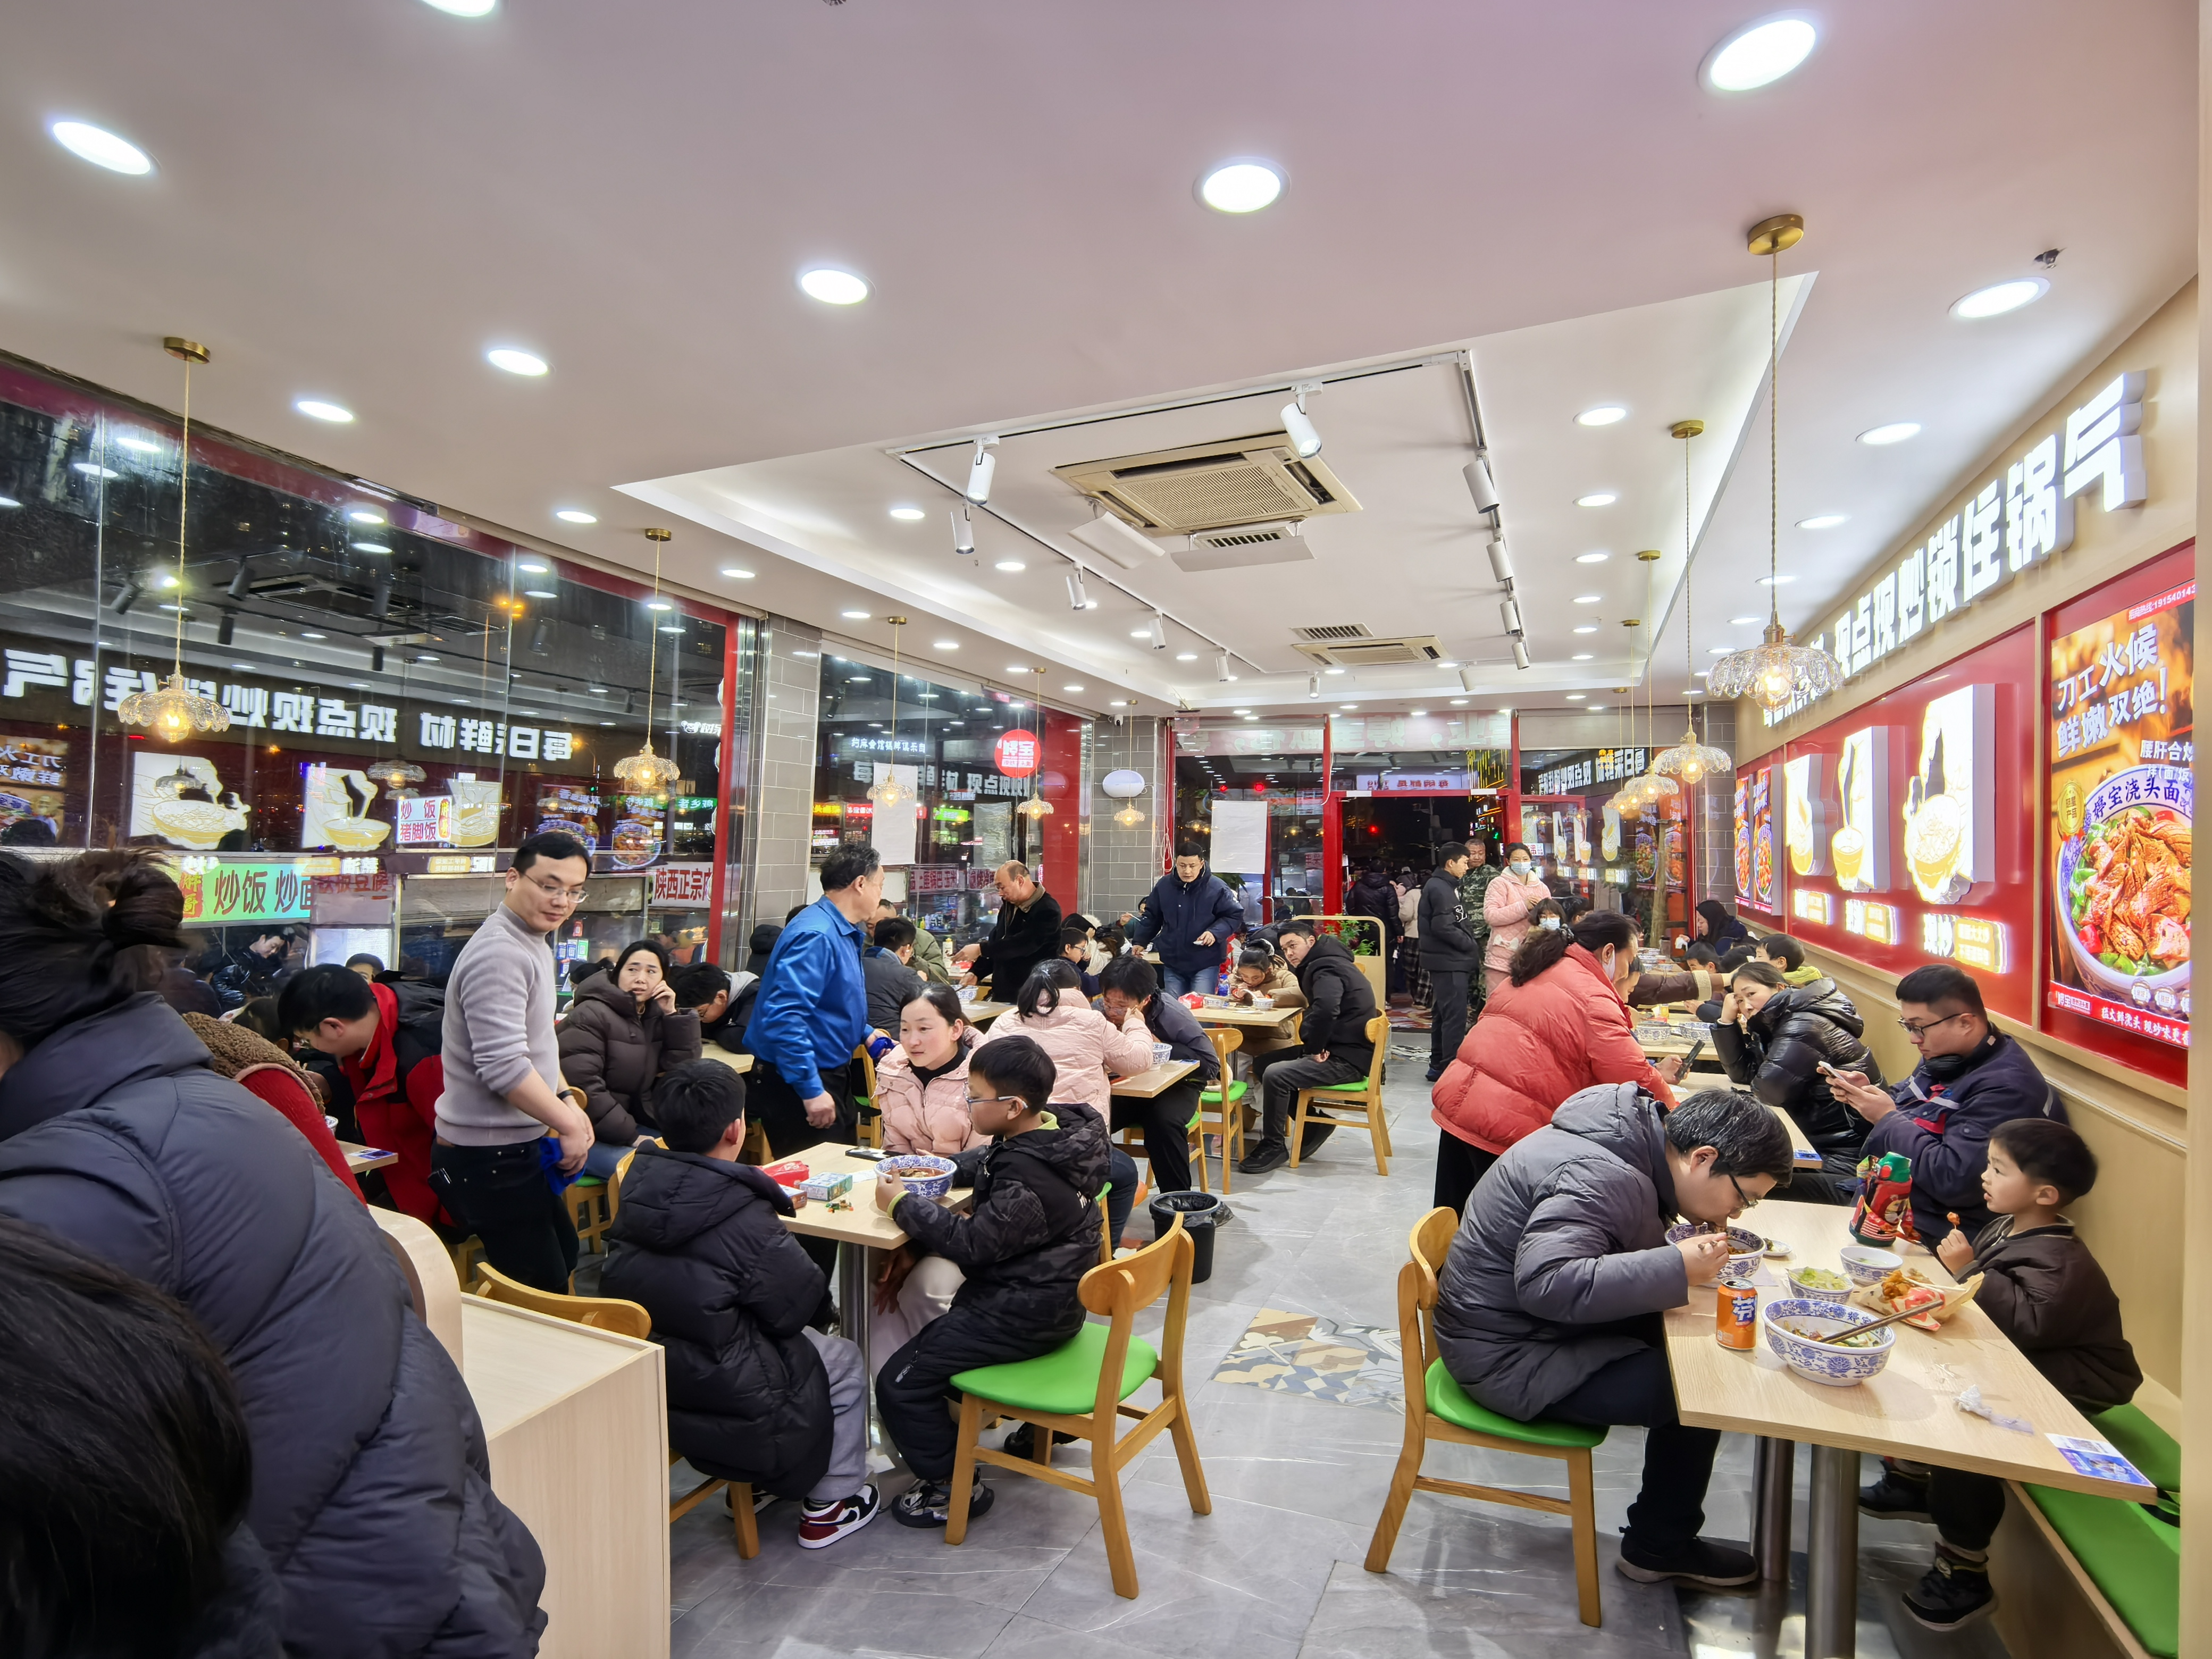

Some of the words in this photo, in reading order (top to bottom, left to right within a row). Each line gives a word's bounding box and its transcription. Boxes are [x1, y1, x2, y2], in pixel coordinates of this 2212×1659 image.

[2058, 623, 2158, 711] 刀工火候
[678, 798, 714, 809] 老乡鸡
[400, 822, 436, 841] 猪脚饭
[213, 869, 268, 915] 炒饭
